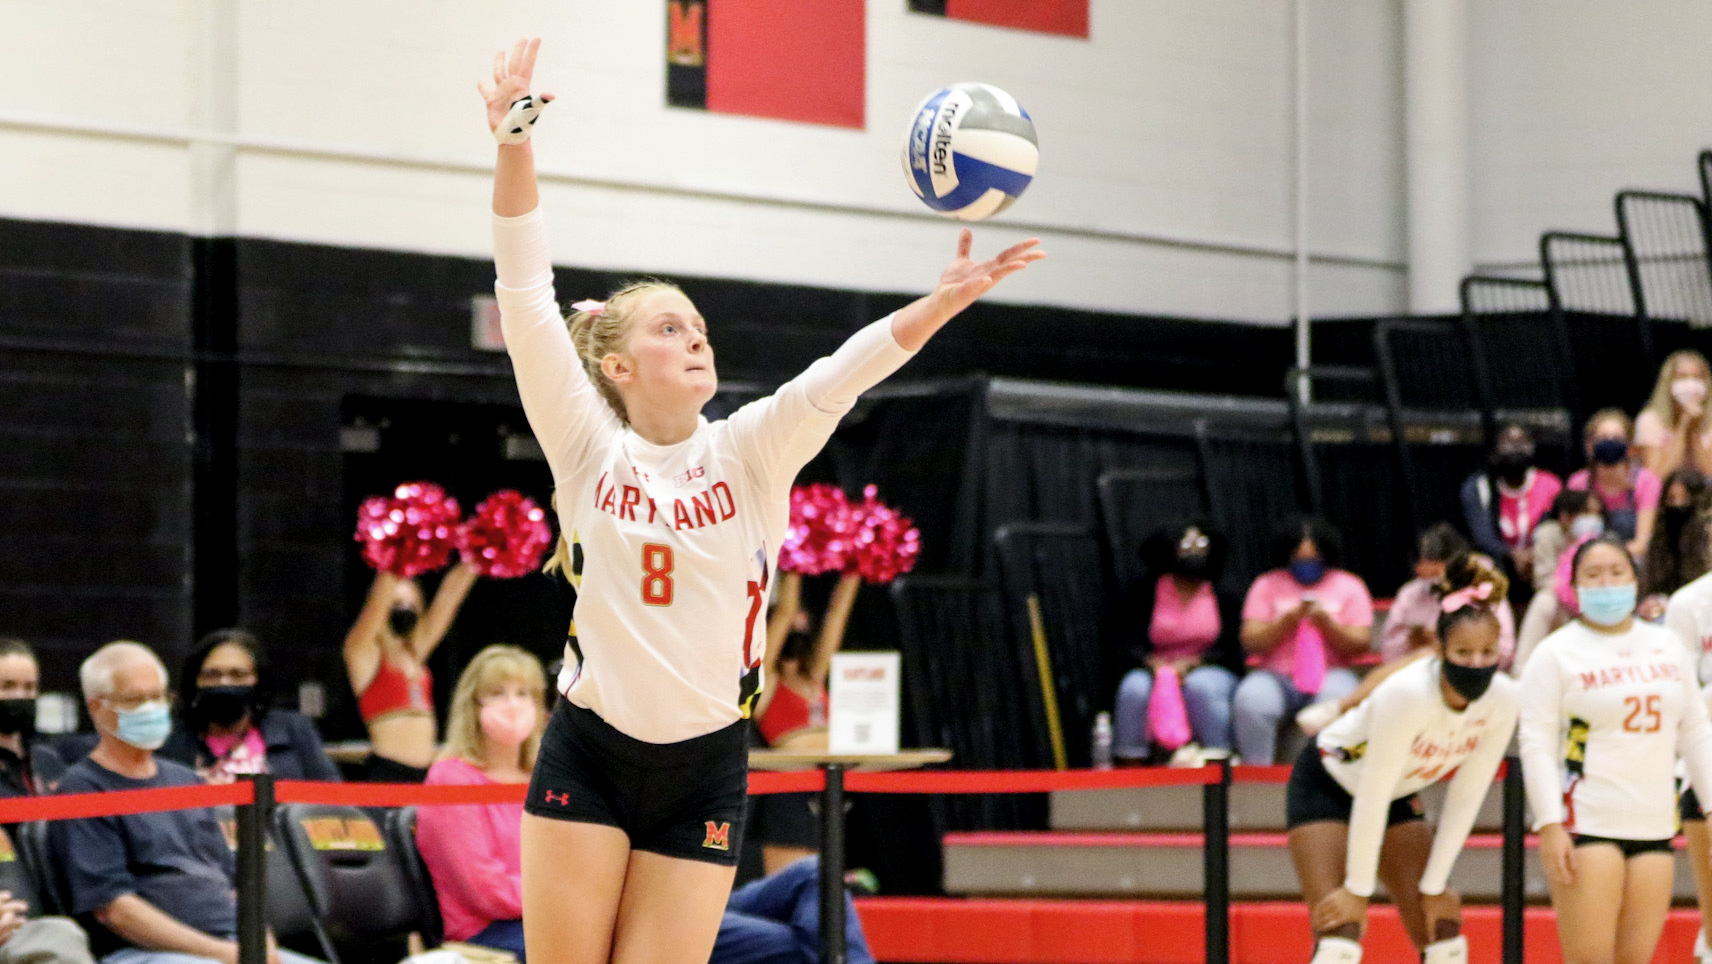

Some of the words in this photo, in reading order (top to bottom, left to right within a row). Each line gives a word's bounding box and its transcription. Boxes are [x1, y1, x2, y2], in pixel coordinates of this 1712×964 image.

[668, 1, 702, 56] M
[932, 102, 959, 175] molten
[594, 471, 736, 530] ARYAND
[641, 542, 674, 606] 8
[1622, 694, 1661, 733] 25
[703, 820, 730, 850] M
